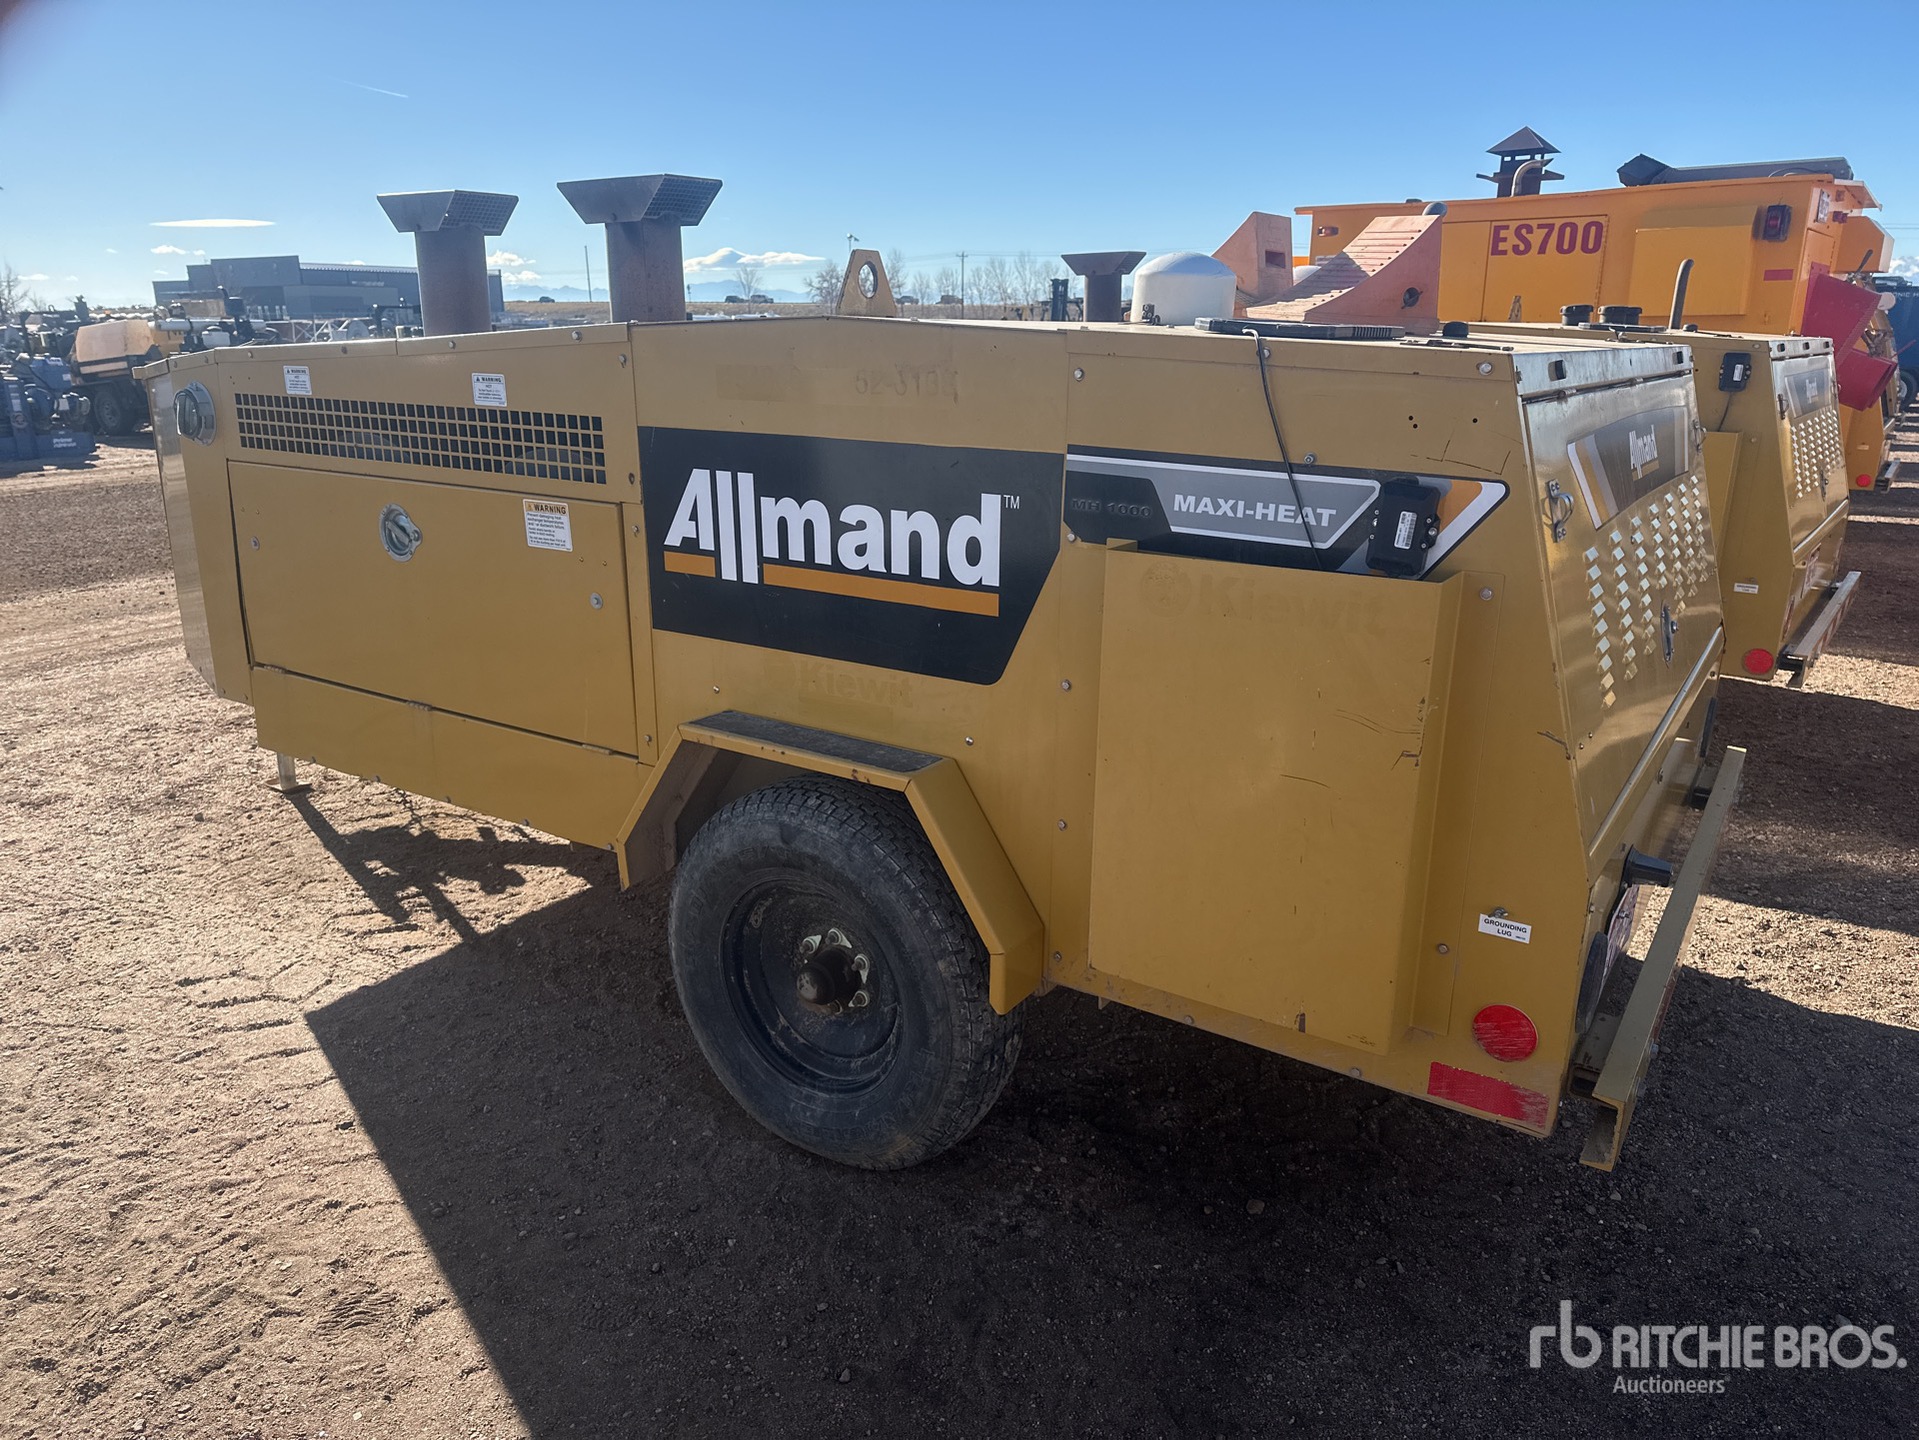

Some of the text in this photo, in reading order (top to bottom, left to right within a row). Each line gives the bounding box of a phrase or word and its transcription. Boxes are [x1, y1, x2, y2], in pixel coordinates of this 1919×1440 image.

[1491, 221, 1604, 256] ES700
[1628, 424, 1658, 479] Allmand
[534, 504, 566, 514] WARNING
[1072, 498, 1152, 517] MH 1000
[1173, 494, 1337, 527] MAXI-HEAT
[663, 468, 1001, 587] Allmand
[1484, 918, 1527, 933] GROUNDING
[1497, 928, 1512, 937] LUG
